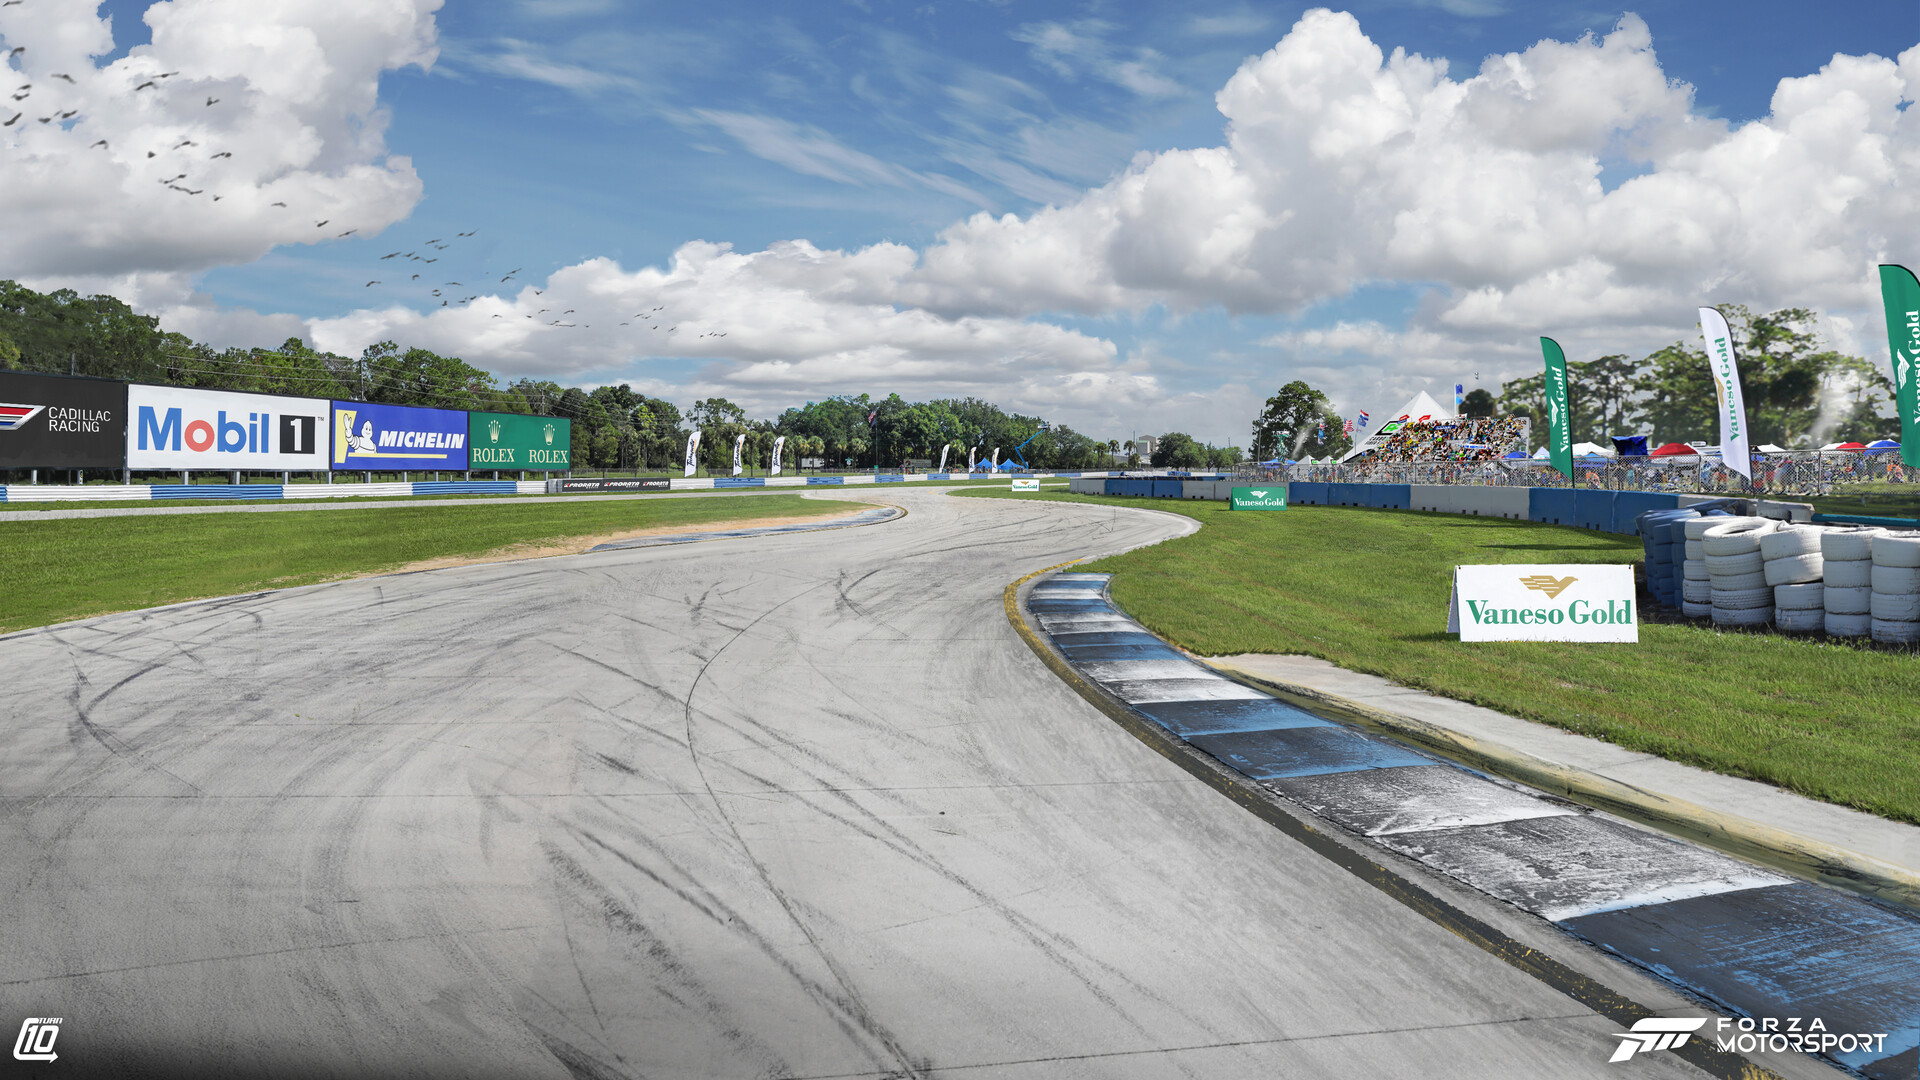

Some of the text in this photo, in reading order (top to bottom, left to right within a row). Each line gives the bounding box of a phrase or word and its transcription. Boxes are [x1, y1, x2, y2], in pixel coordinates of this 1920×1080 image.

[1906, 310, 1920, 355] Gold
[1714, 337, 1740, 442] Vaneso Gold
[48, 406, 111, 422] CADILLAC
[1551, 366, 1569, 453] Vaneso Gold
[48, 420, 100, 433] RACING
[138, 406, 270, 453] Mobil
[290, 418, 302, 452] 1
[378, 430, 465, 449] MICHELIN
[473, 448, 515, 463] ROLEX
[529, 450, 569, 463] ROLEX
[1234, 497, 1284, 506] Vaneso Gold
[1466, 599, 1633, 625] Vaneso Gold
